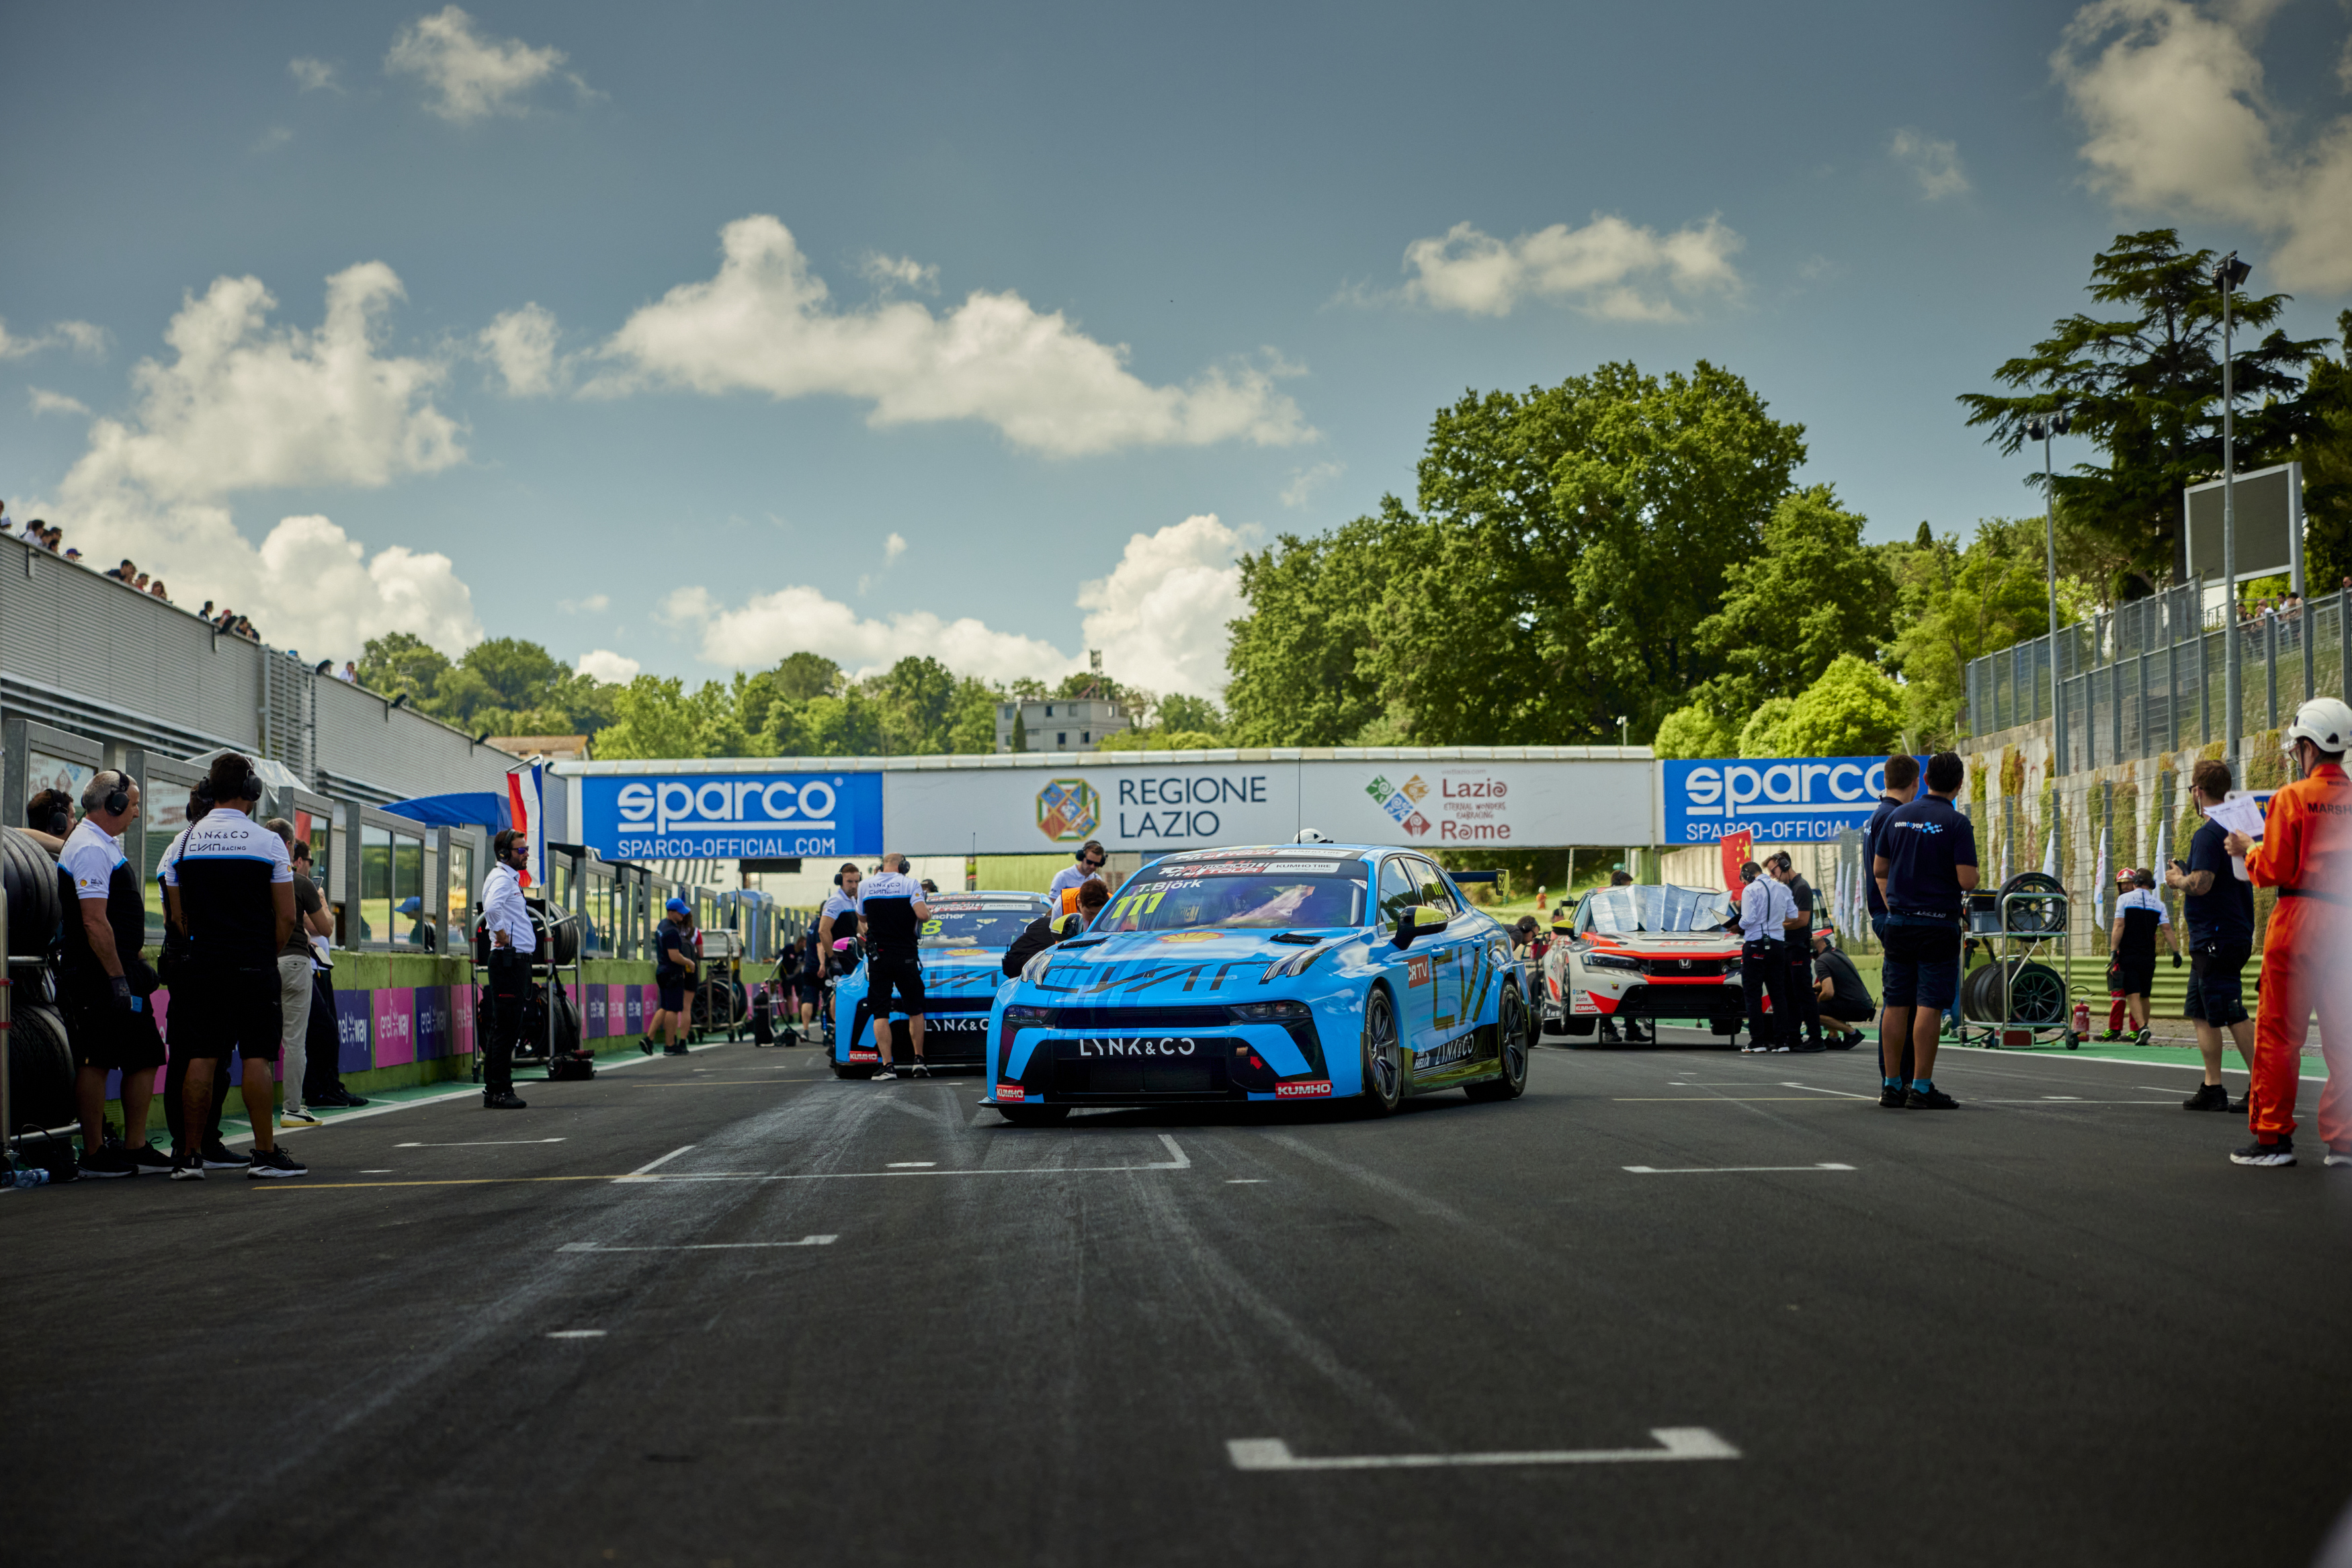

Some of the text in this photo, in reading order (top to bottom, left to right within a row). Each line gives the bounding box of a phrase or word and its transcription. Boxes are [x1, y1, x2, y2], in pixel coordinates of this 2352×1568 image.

[1119, 777, 1267, 805] REGIONE
[1442, 778, 1507, 798] Lazio
[1685, 763, 1886, 818] sparco
[617, 781, 836, 835] sparco
[1443, 802, 1506, 811] ETERNAL WONDERS
[1456, 811, 1494, 820] EMBRACING
[2307, 802, 2352, 815] MARSH
[1119, 810, 1220, 838] LAZIO
[1441, 820, 1511, 840] Rome
[618, 837, 836, 858] SPARCO-OFFICIAL.COM
[1138, 879, 1204, 892] T.Björk
[1498, 873, 1505, 891] 62
[1111, 891, 1167, 919] 111
[921, 919, 943, 934] 8
[380, 1008, 409, 1044] enel way
[421, 1006, 431, 1034] enel
[925, 1018, 990, 1031] LYNK&C
[338, 1012, 368, 1051] nel way
[1413, 1053, 1431, 1070] HELIX
[997, 1087, 1023, 1098] KUMHO
[1277, 1084, 1331, 1096] KUMHO
